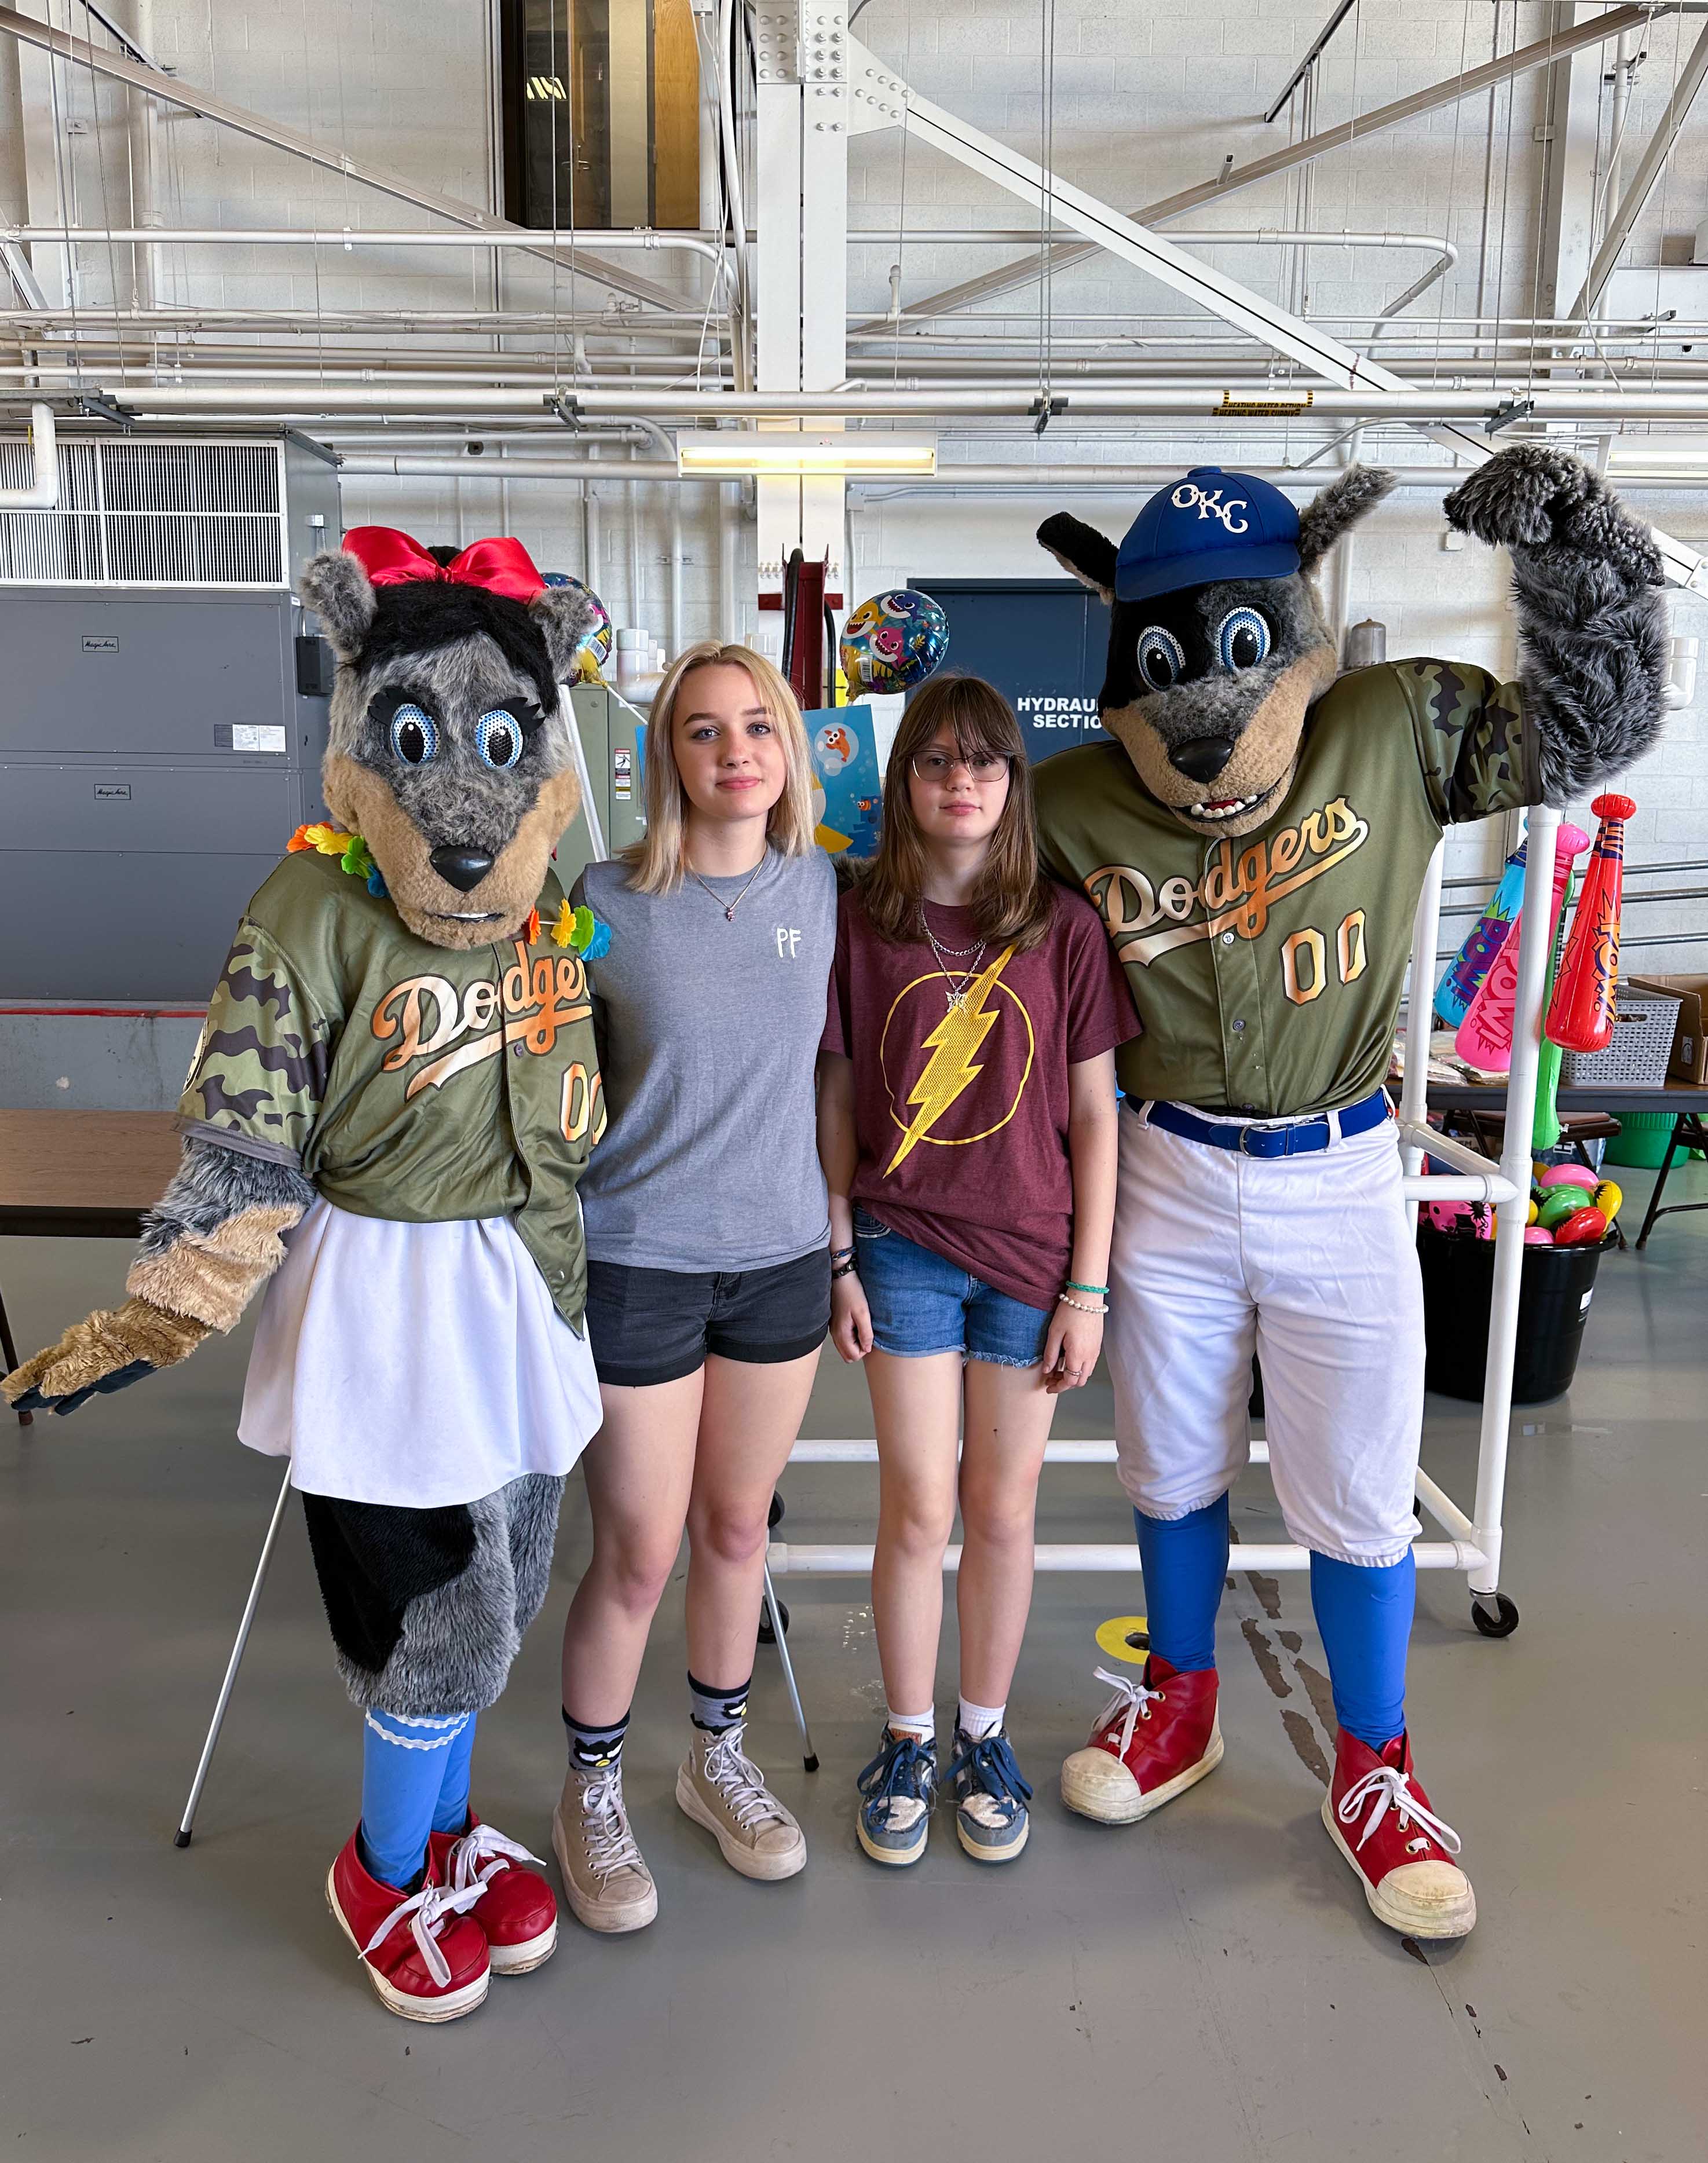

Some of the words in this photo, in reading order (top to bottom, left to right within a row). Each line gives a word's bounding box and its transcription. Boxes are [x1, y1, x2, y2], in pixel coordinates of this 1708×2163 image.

[1171, 484, 1248, 533] OKC
[1017, 697, 1099, 712] HYDRAU
[1083, 794, 1370, 940] Dodgers
[777, 928, 802, 959] PF
[1279, 906, 1369, 1007] 00
